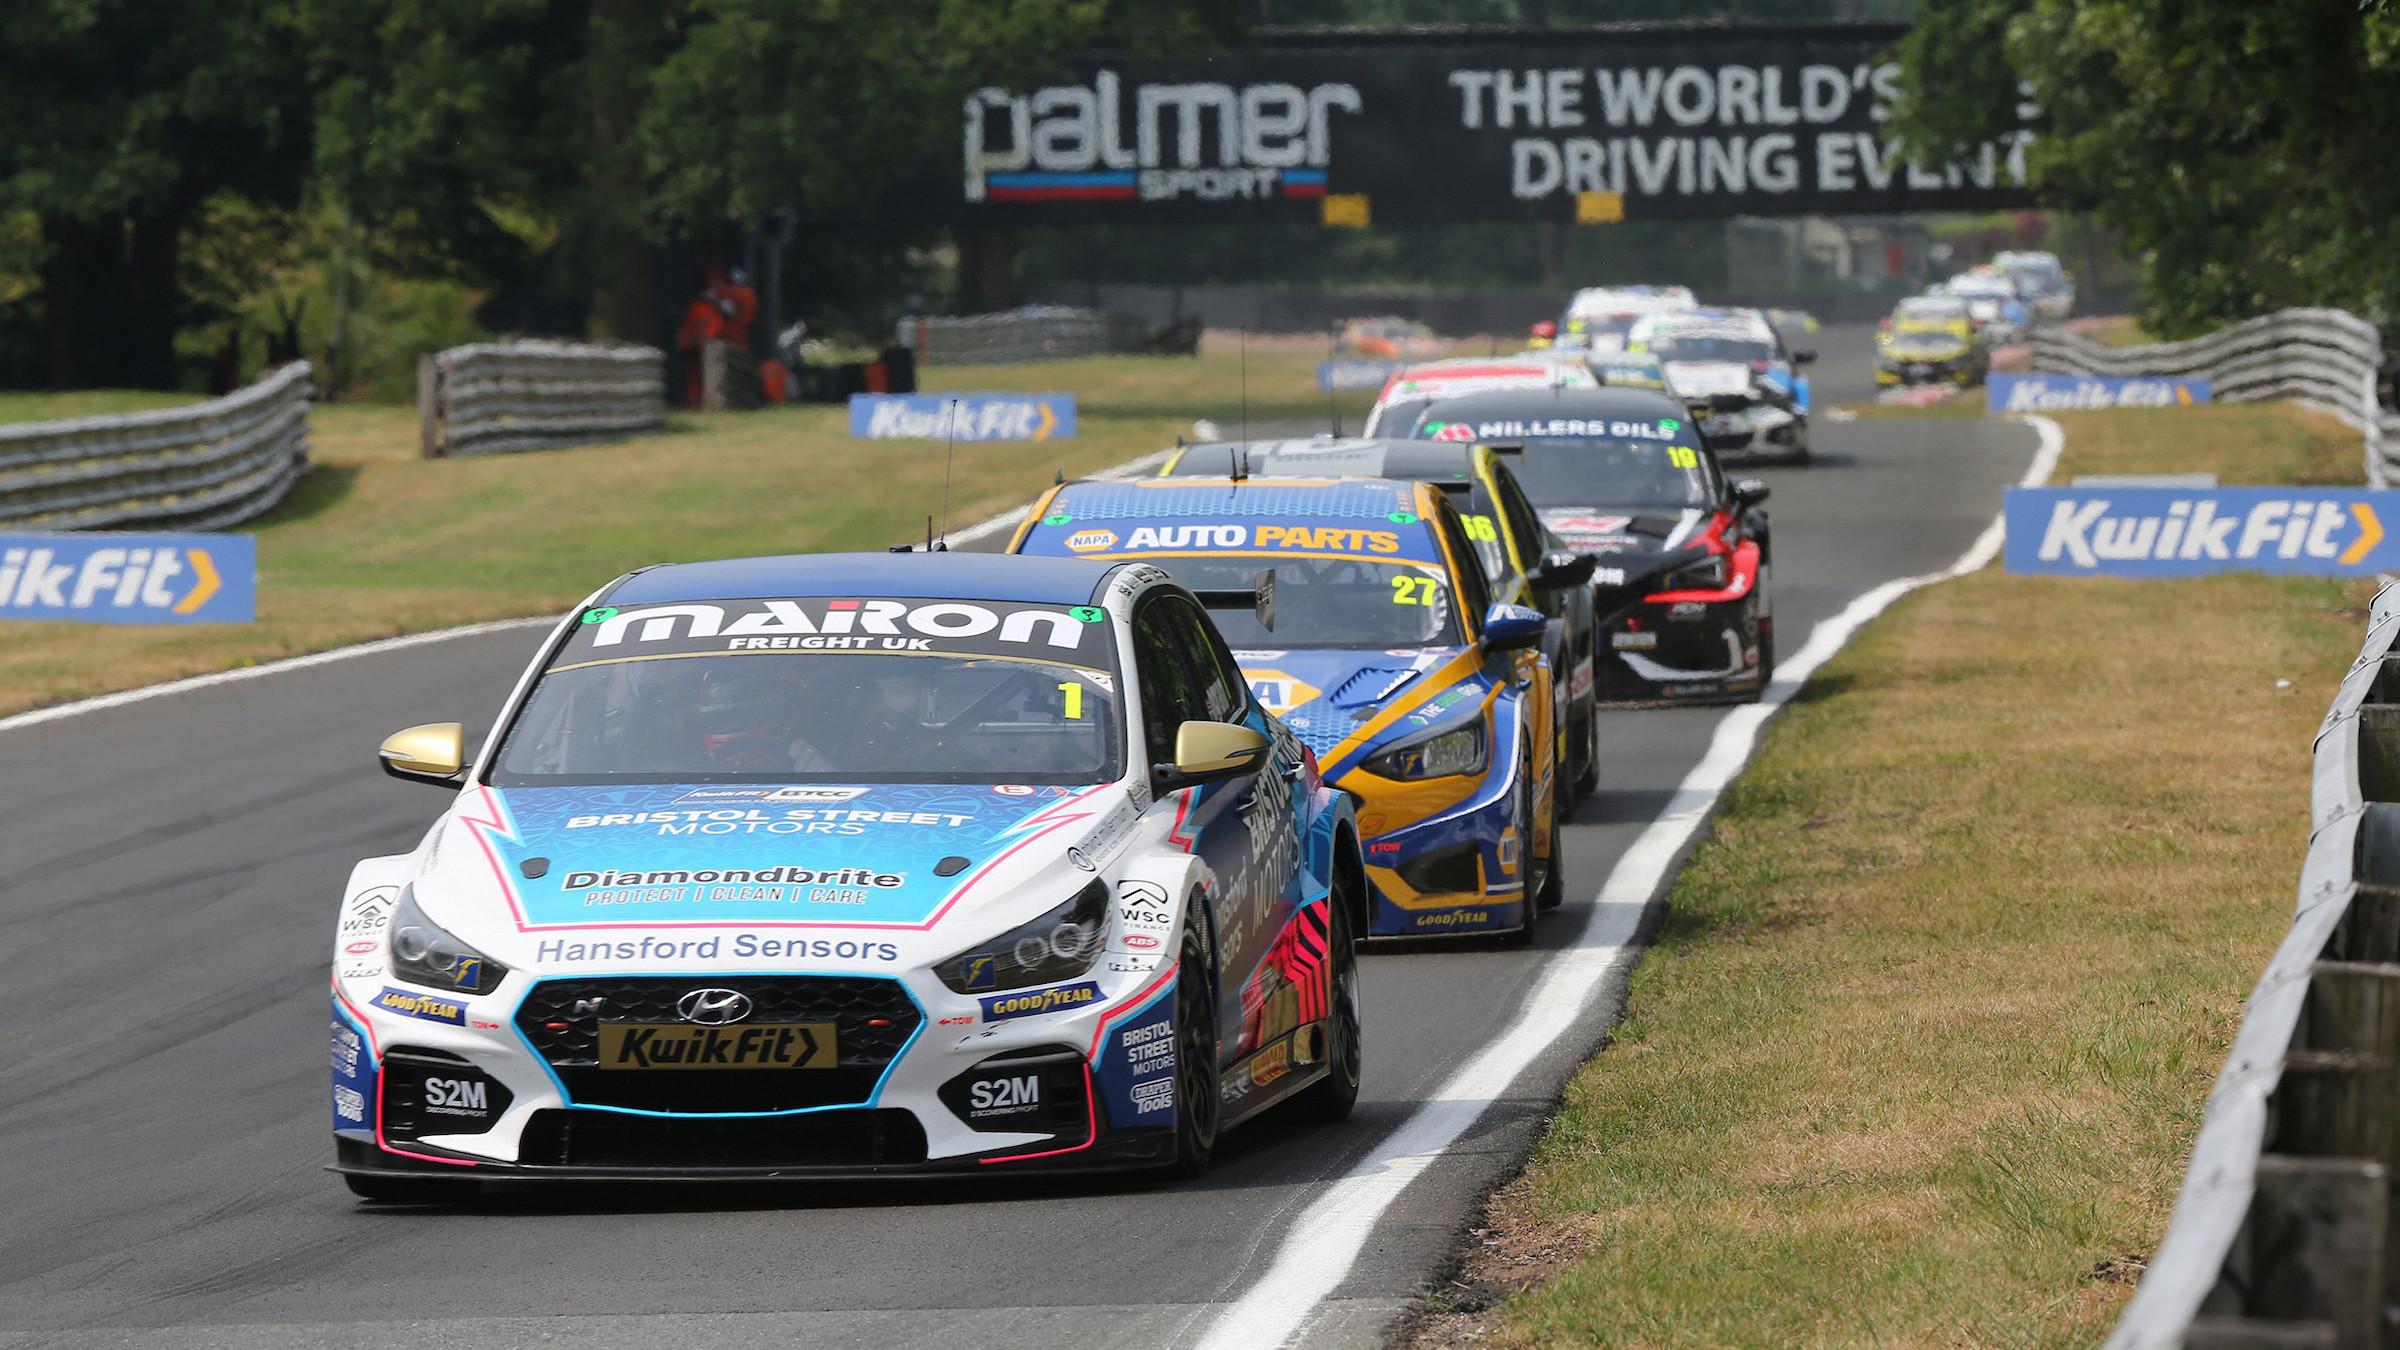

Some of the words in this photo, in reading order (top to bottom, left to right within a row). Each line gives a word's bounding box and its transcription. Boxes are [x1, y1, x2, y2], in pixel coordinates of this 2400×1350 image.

[1448, 68, 1585, 128] THE
[963, 68, 1362, 203] palmer
[1511, 133, 1799, 198] DRIVING
[1137, 168, 1281, 200] SPORT
[1479, 420, 1606, 438] MILLERS
[1612, 420, 1675, 441] OILS
[1667, 446, 1698, 469] 19
[1073, 535, 1110, 546] NAPA
[1125, 525, 1247, 549] AUTO
[1254, 526, 1400, 553] PARTS
[1391, 574, 1437, 607] 27
[728, 636, 879, 650] FREIGHT
[882, 638, 934, 651] UK
[1058, 683, 1082, 719] 1
[565, 809, 770, 829] BRISTOL
[784, 809, 974, 827] STREET
[657, 821, 866, 836] MOTORS
[1379, 842, 1401, 853] TOW
[563, 866, 903, 891] Diamondbrite
[585, 887, 686, 905] PROTECT
[712, 887, 780, 902] CLEAN
[811, 889, 868, 905] CARE
[344, 916, 387, 931] WSC
[1121, 908, 1171, 925] WSC
[1417, 909, 1488, 926] GOODYEAR
[536, 935, 720, 963] Hansford
[733, 934, 899, 961] Sensors
[1127, 935, 1157, 948] ABS
[993, 987, 1094, 1014] GOODYEAR
[952, 1017, 974, 1026] TOW
[1123, 1020, 1174, 1047] BRISTOL
[1128, 1037, 1175, 1062] STREET
[1133, 1055, 1175, 1076] MOTORS
[424, 1077, 488, 1109] S2M
[970, 1075, 1039, 1109] S2M
